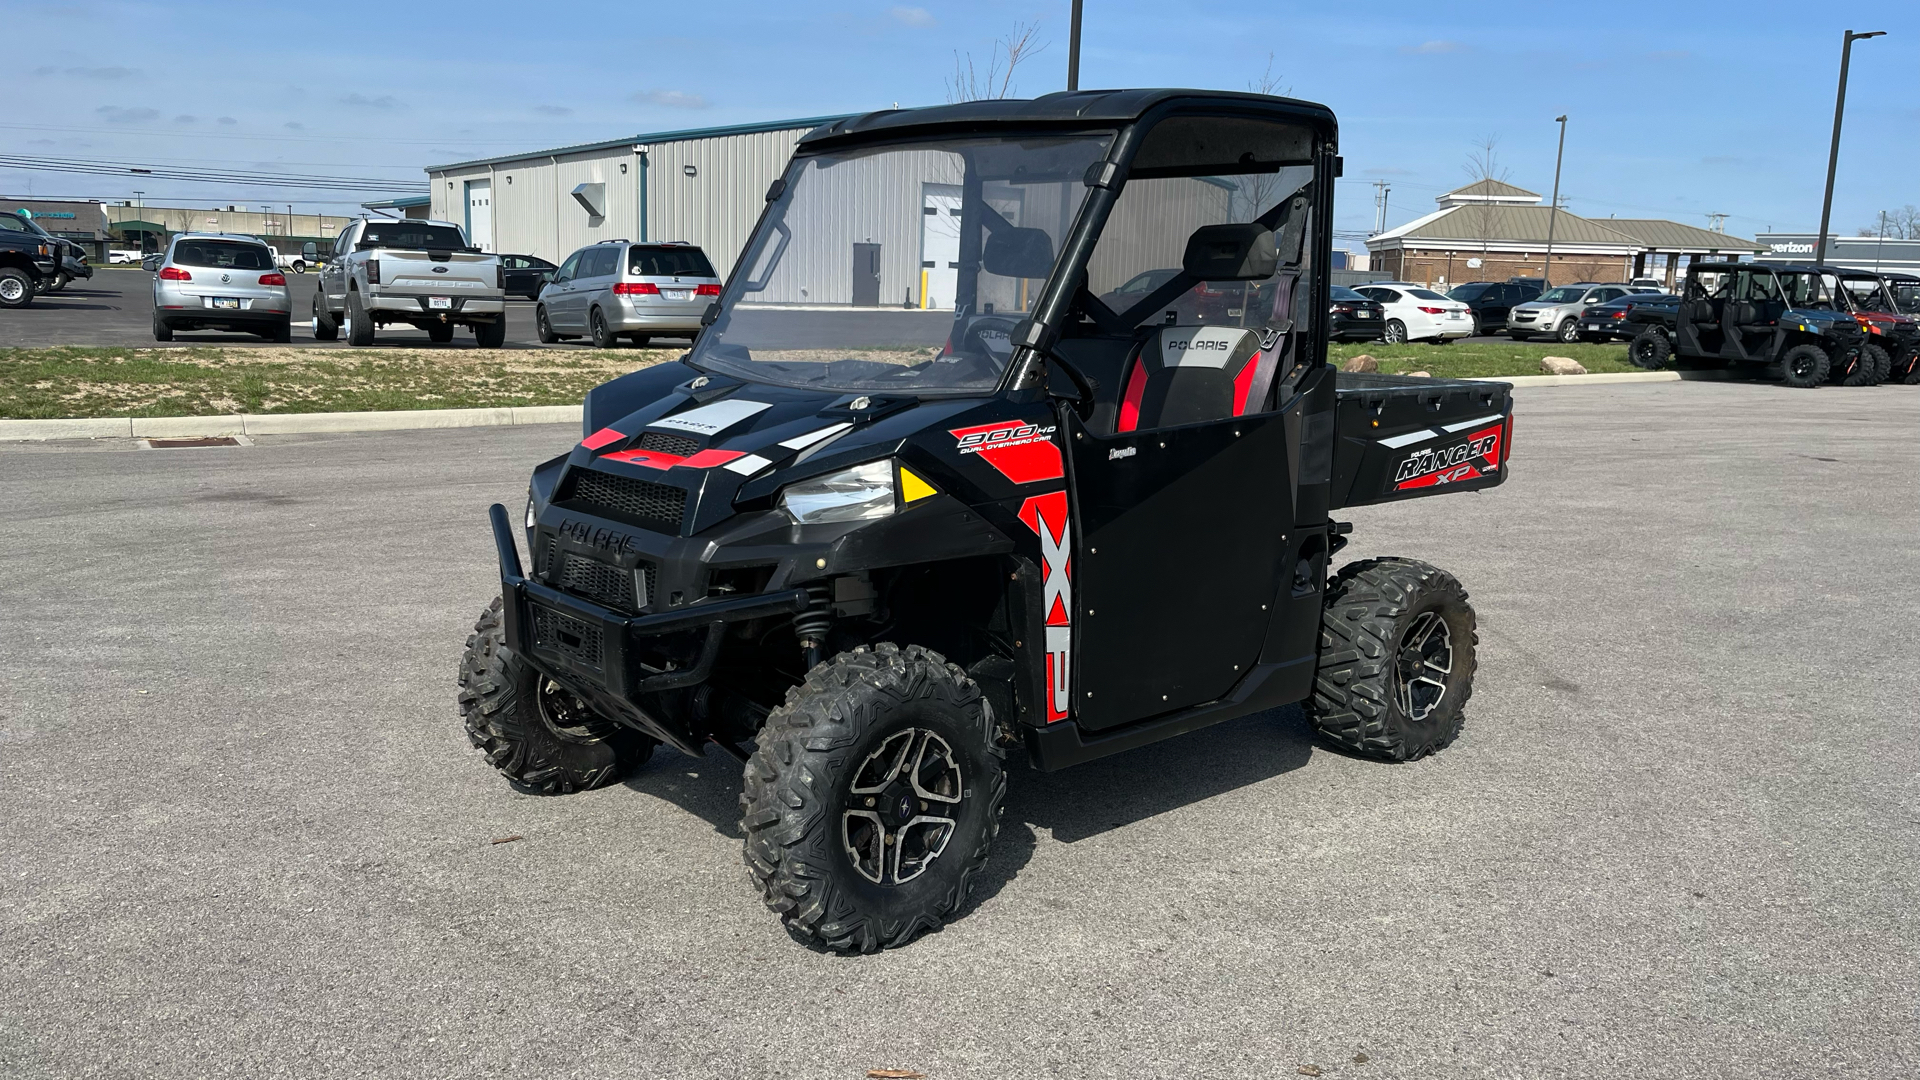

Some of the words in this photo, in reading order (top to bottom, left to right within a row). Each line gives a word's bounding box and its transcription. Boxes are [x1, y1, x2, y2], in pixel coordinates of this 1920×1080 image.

[1770, 241, 1813, 253] verizon
[978, 329, 1010, 340] OLAR
[1168, 340, 1229, 351] POLARIS
[956, 424, 1038, 449] 900
[1037, 425, 1057, 434] HD
[960, 446, 985, 454] DUAL
[986, 438, 1032, 450] OVERHEAD
[1033, 435, 1052, 443] CAM
[1394, 434, 1497, 482] RANGER
[1410, 447, 1432, 459] POLARIS
[1434, 465, 1472, 486] XP
[558, 517, 642, 556] POLARIS
